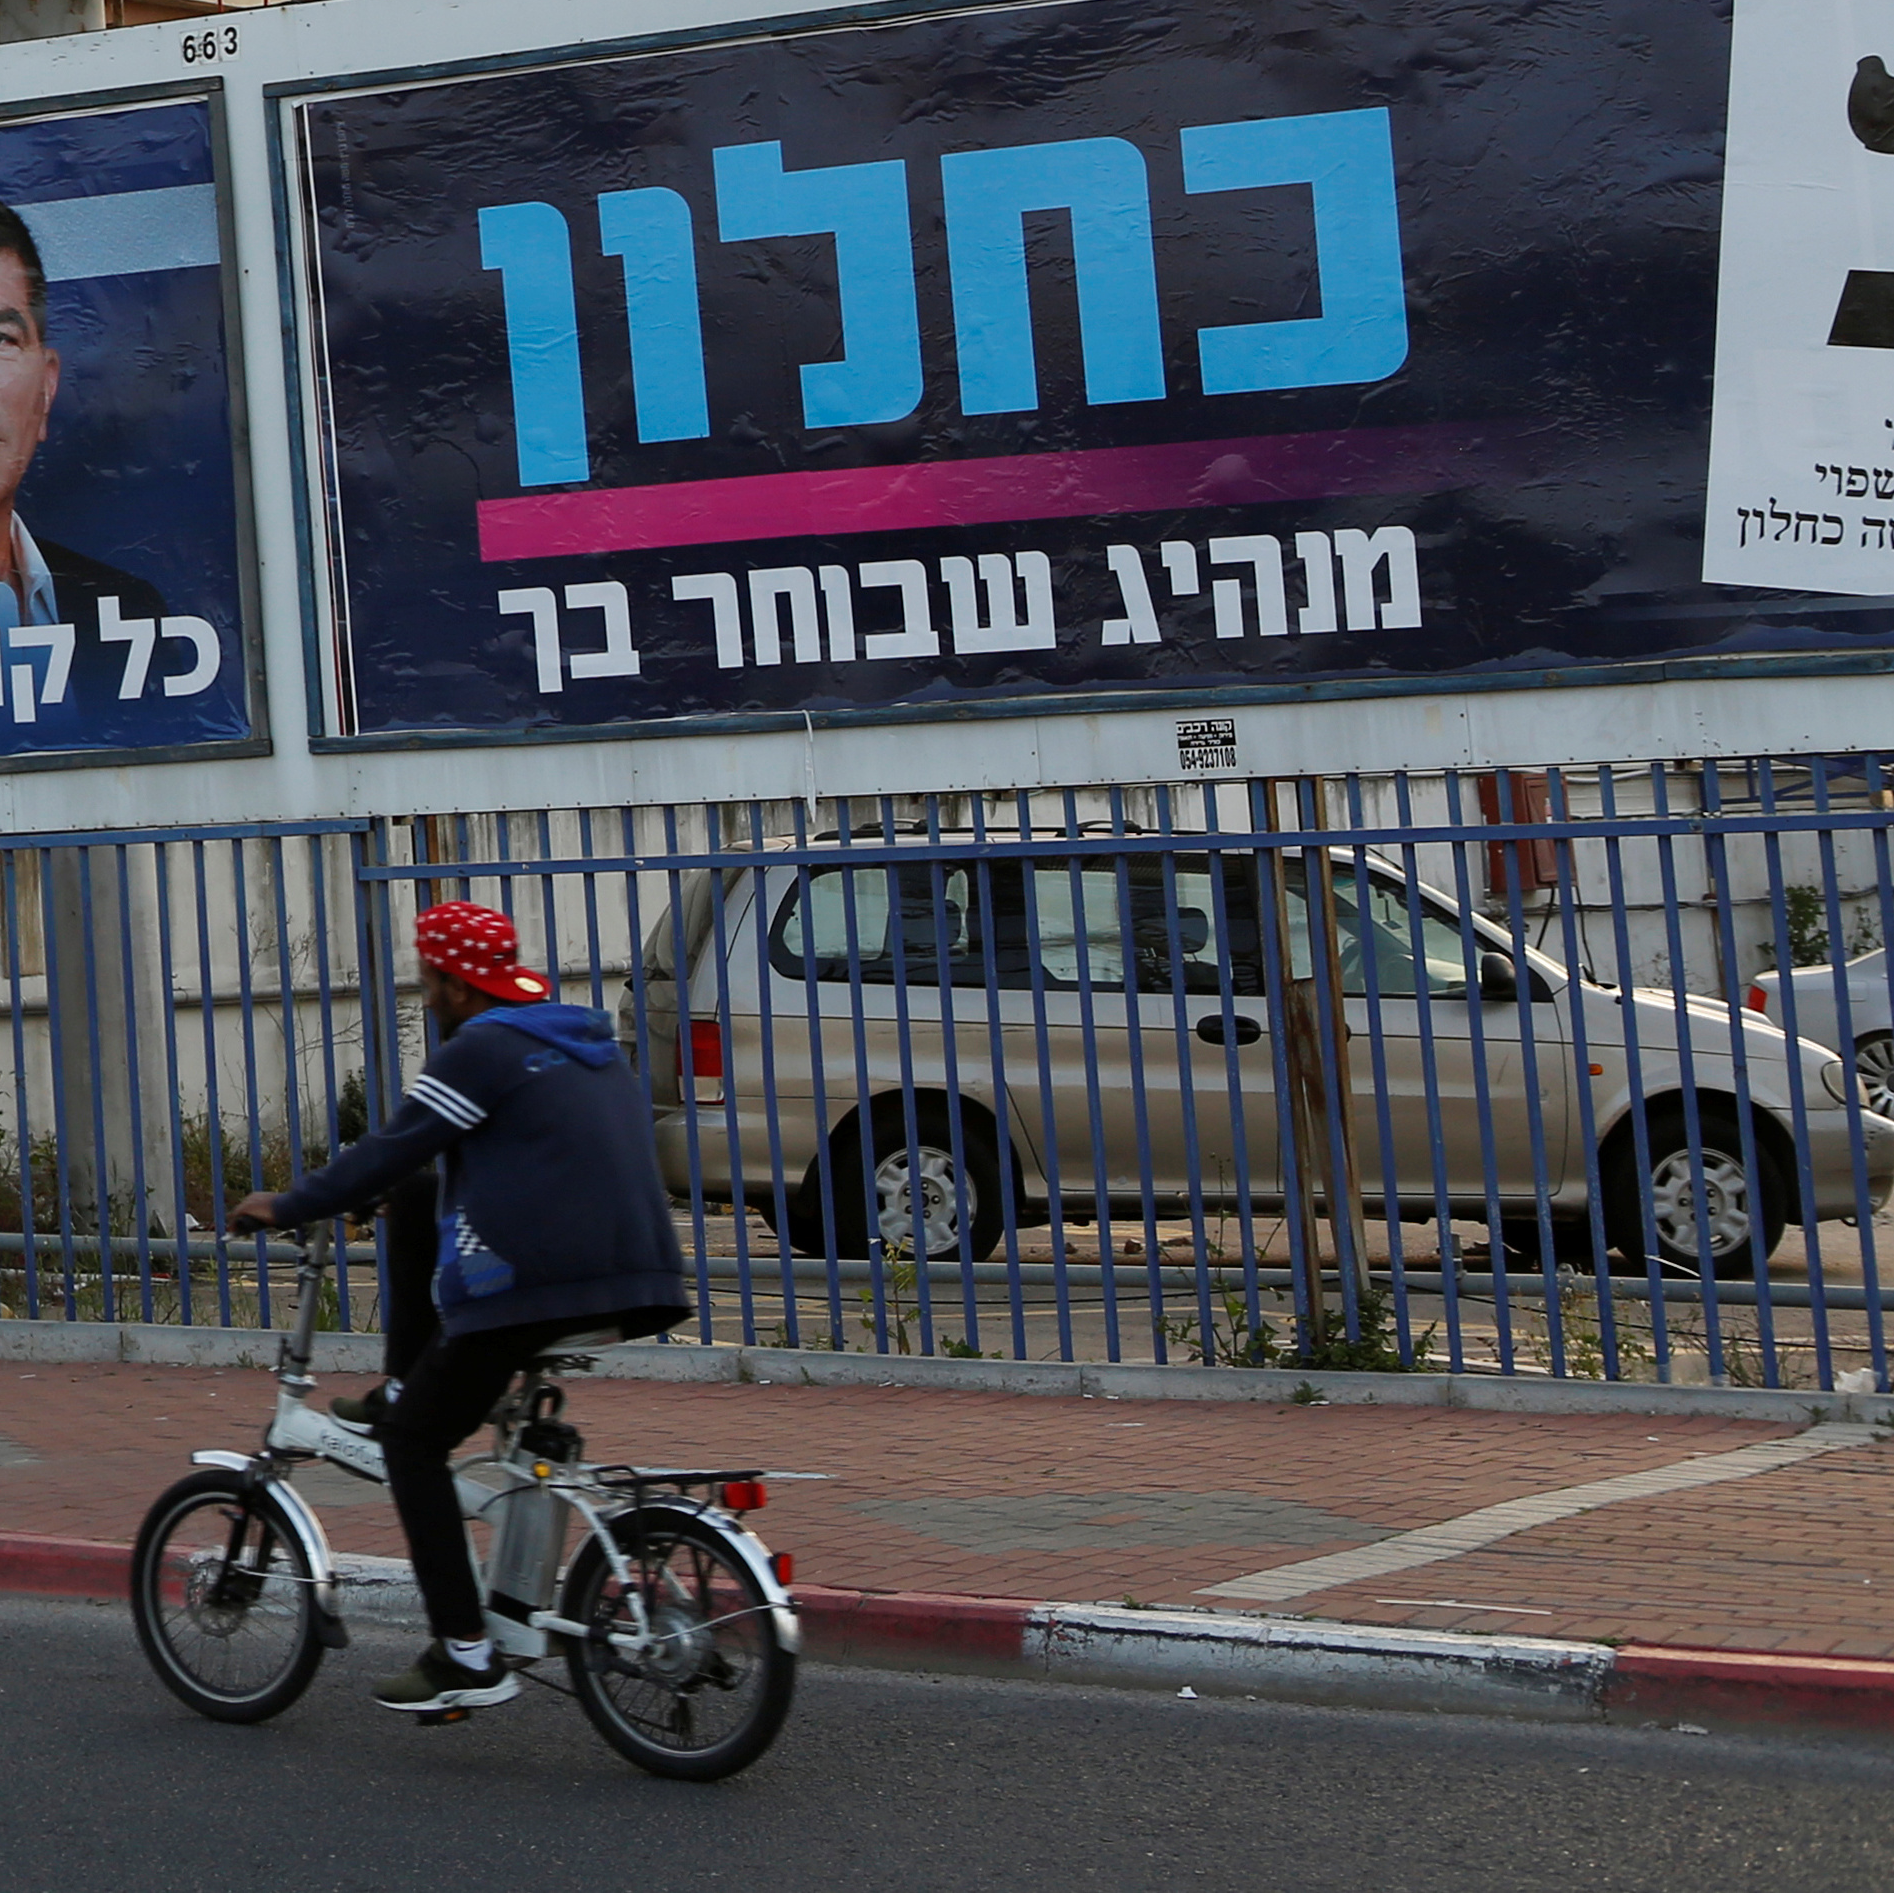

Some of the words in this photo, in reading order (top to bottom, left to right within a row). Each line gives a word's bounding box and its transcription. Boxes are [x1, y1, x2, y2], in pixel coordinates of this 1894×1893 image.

[183, 27, 237, 63] 663
[477, 106, 1410, 487] כחלון
[1737, 497, 1844, 548] כחלון
[498, 580, 640, 694] בך
[672, 551, 1056, 669] שבוחר
[1100, 524, 1422, 647] מנהיג
[97, 595, 221, 699] כל
